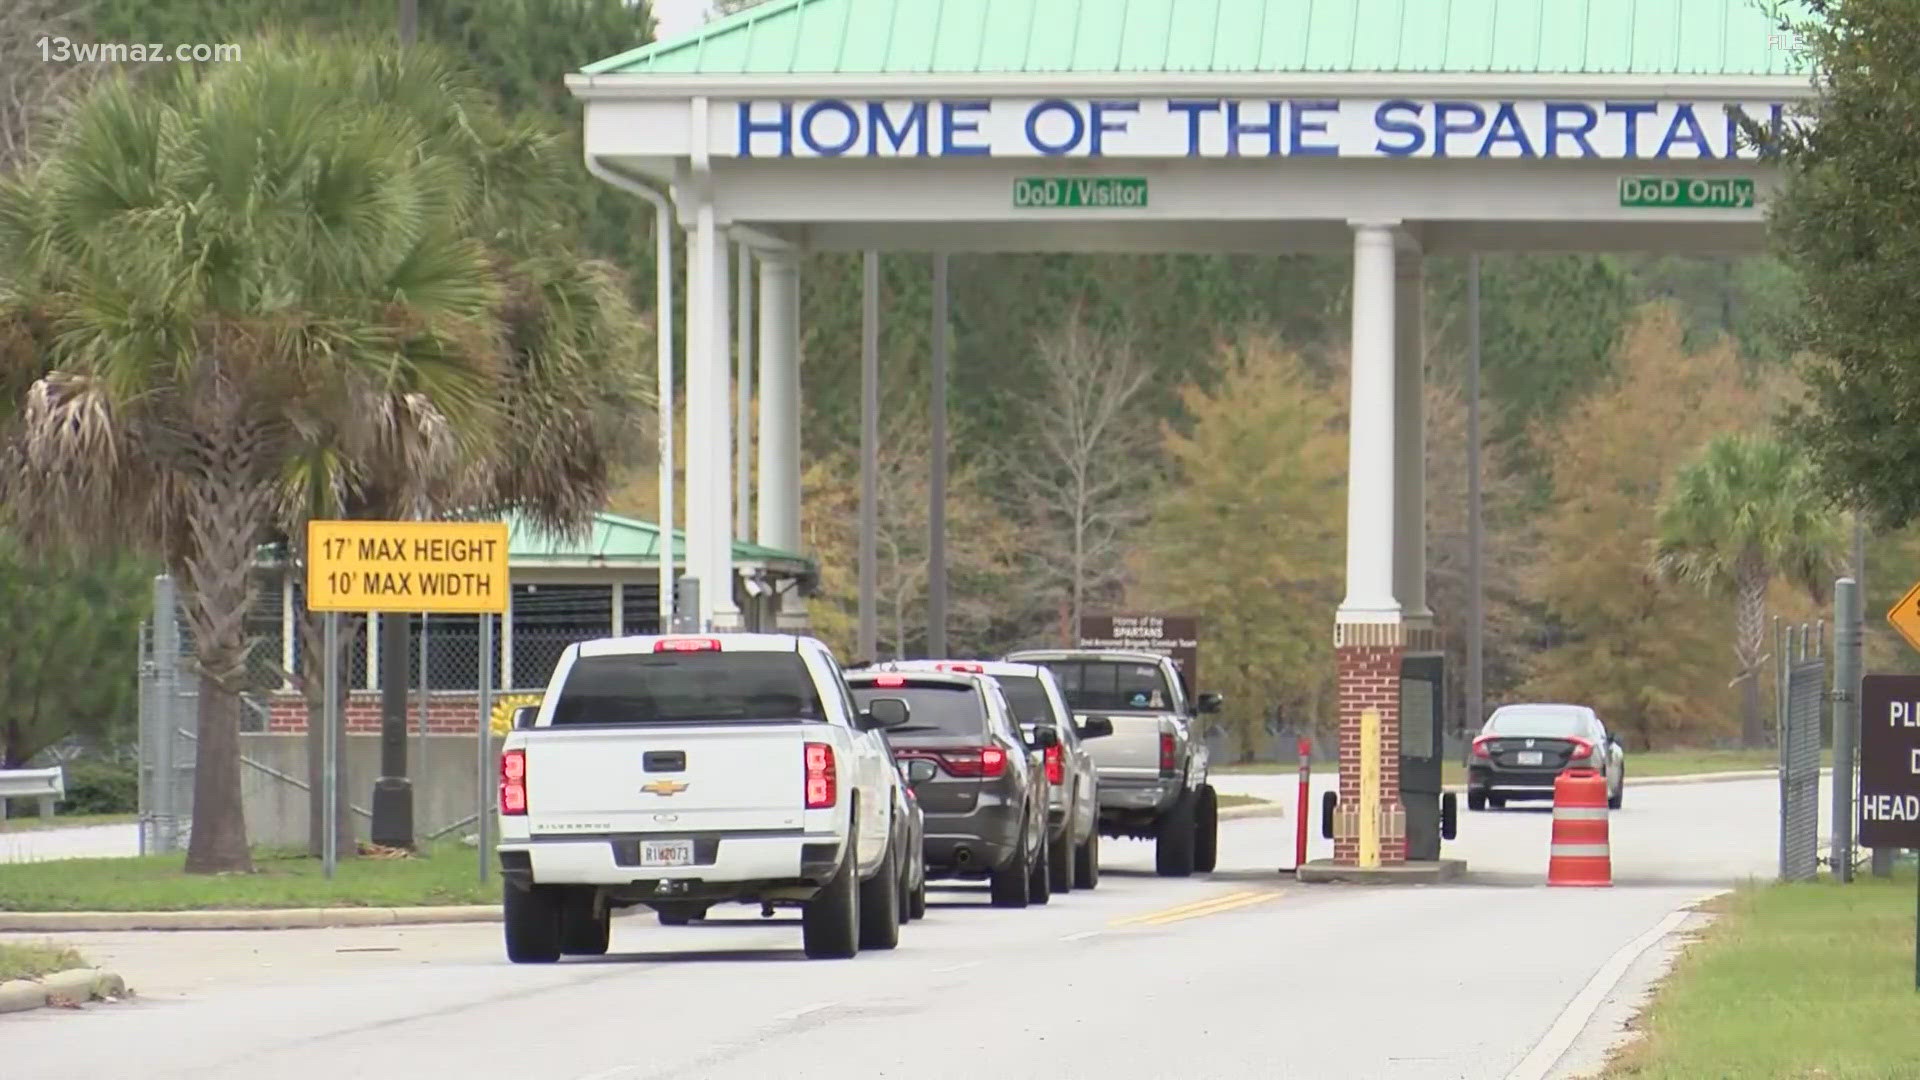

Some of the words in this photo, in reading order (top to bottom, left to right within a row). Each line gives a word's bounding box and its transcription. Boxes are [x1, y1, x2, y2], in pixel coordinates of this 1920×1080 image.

[738, 99, 989, 157] HOME
[1024, 99, 1139, 157] OF
[1168, 99, 1339, 157] THE
[1374, 99, 1800, 158] SPARTAN
[1016, 180, 1060, 205] DoD
[1077, 179, 1146, 206] Visitor
[1622, 180, 1680, 202] DoD
[1687, 180, 1751, 207] Only
[323, 537, 352, 560] 17'
[358, 538, 406, 561] MAX
[414, 539, 497, 562] HEIGHT
[328, 571, 357, 595] 10'
[363, 572, 412, 595] MAX
[419, 573, 491, 596] WIDTH
[1113, 627, 1164, 638] SPARTANS
[1889, 701, 1920, 727] PL
[1863, 795, 1920, 820] HEAD
